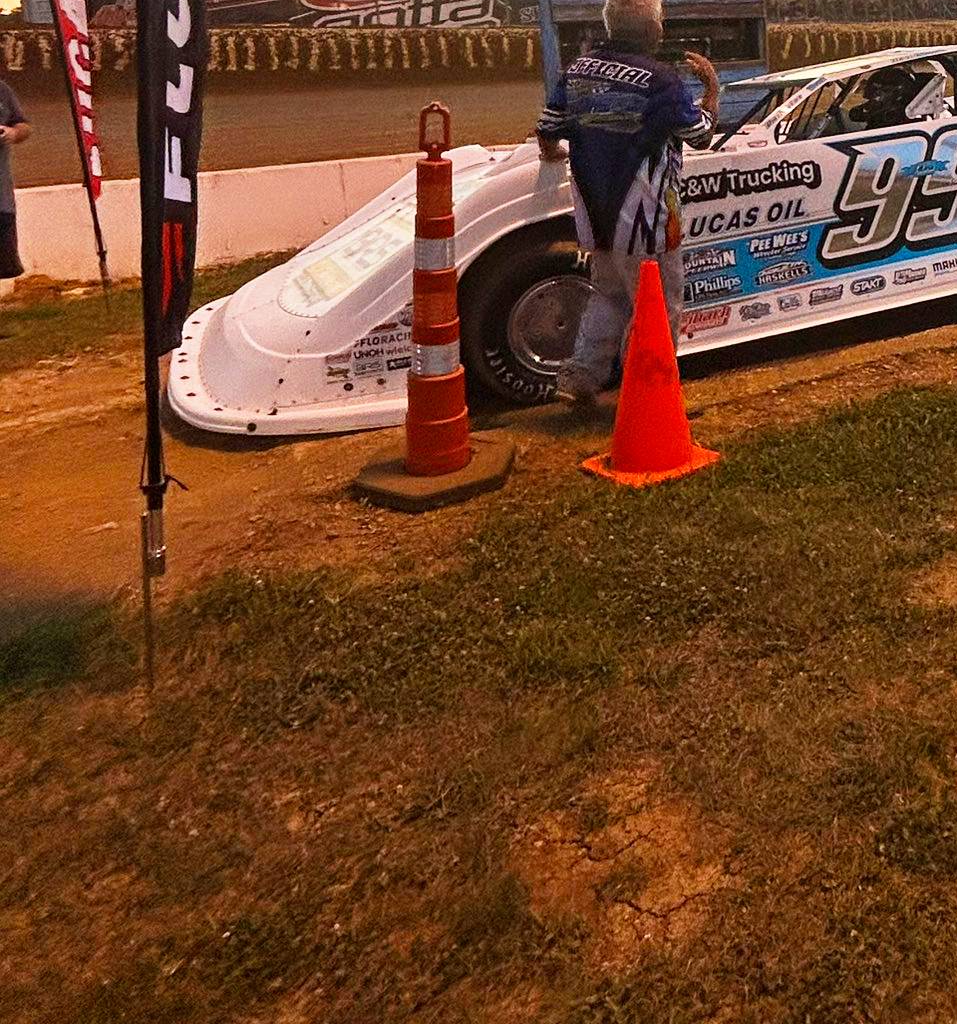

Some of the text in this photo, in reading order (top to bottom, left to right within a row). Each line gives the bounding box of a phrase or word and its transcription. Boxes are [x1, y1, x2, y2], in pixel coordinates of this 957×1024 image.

[567, 57, 652, 88] OFFICIAL
[727, 163, 814, 190] Trucking
[682, 199, 805, 237] UCAS OIL
[750, 230, 809, 252] PEE WEE'S
[684, 249, 737, 271] OUNTAIN
[694, 275, 742, 294] Phillips
[758, 267, 808, 285] HASKELLS
[353, 348, 384, 360] UNOH
